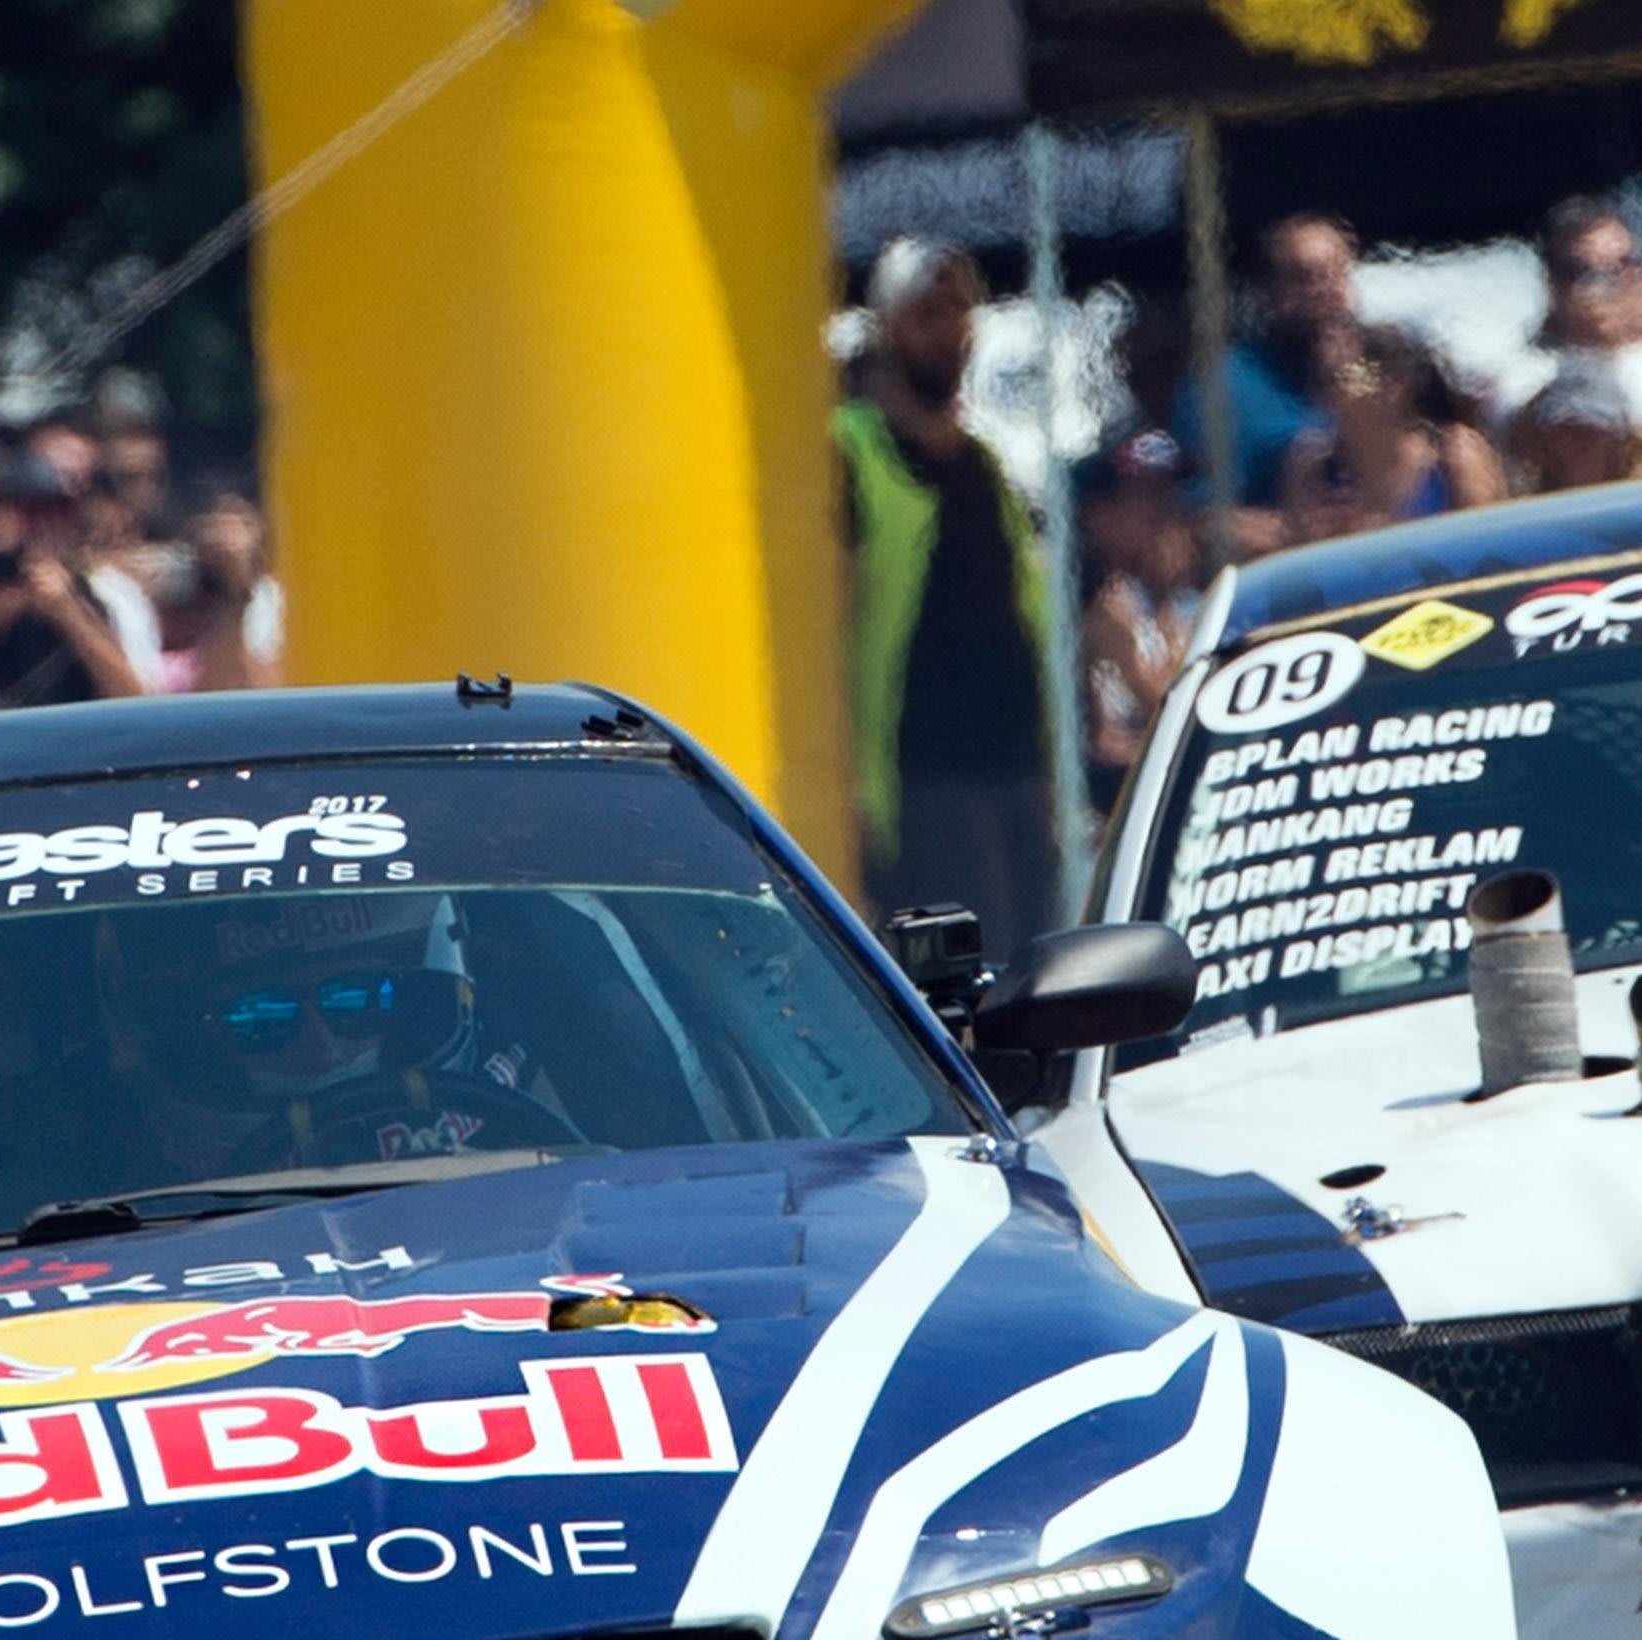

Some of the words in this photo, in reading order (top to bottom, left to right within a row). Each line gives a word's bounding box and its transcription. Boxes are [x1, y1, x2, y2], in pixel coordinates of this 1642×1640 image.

[1227, 650, 1333, 716] 09
[1203, 725, 1360, 785] BPLAN
[1368, 700, 1556, 752] RACING
[309, 797, 388, 815] 2017
[1191, 775, 1299, 828] JDM
[1309, 748, 1487, 801] WORKS
[1167, 855, 1315, 922] NORM
[1323, 826, 1524, 882] REKLAM
[1175, 798, 1415, 875] NANKANG
[137, 862, 415, 895] SERIES
[1187, 873, 1477, 959] EARN2DRIFT
[117, 1352, 740, 1504] Bull
